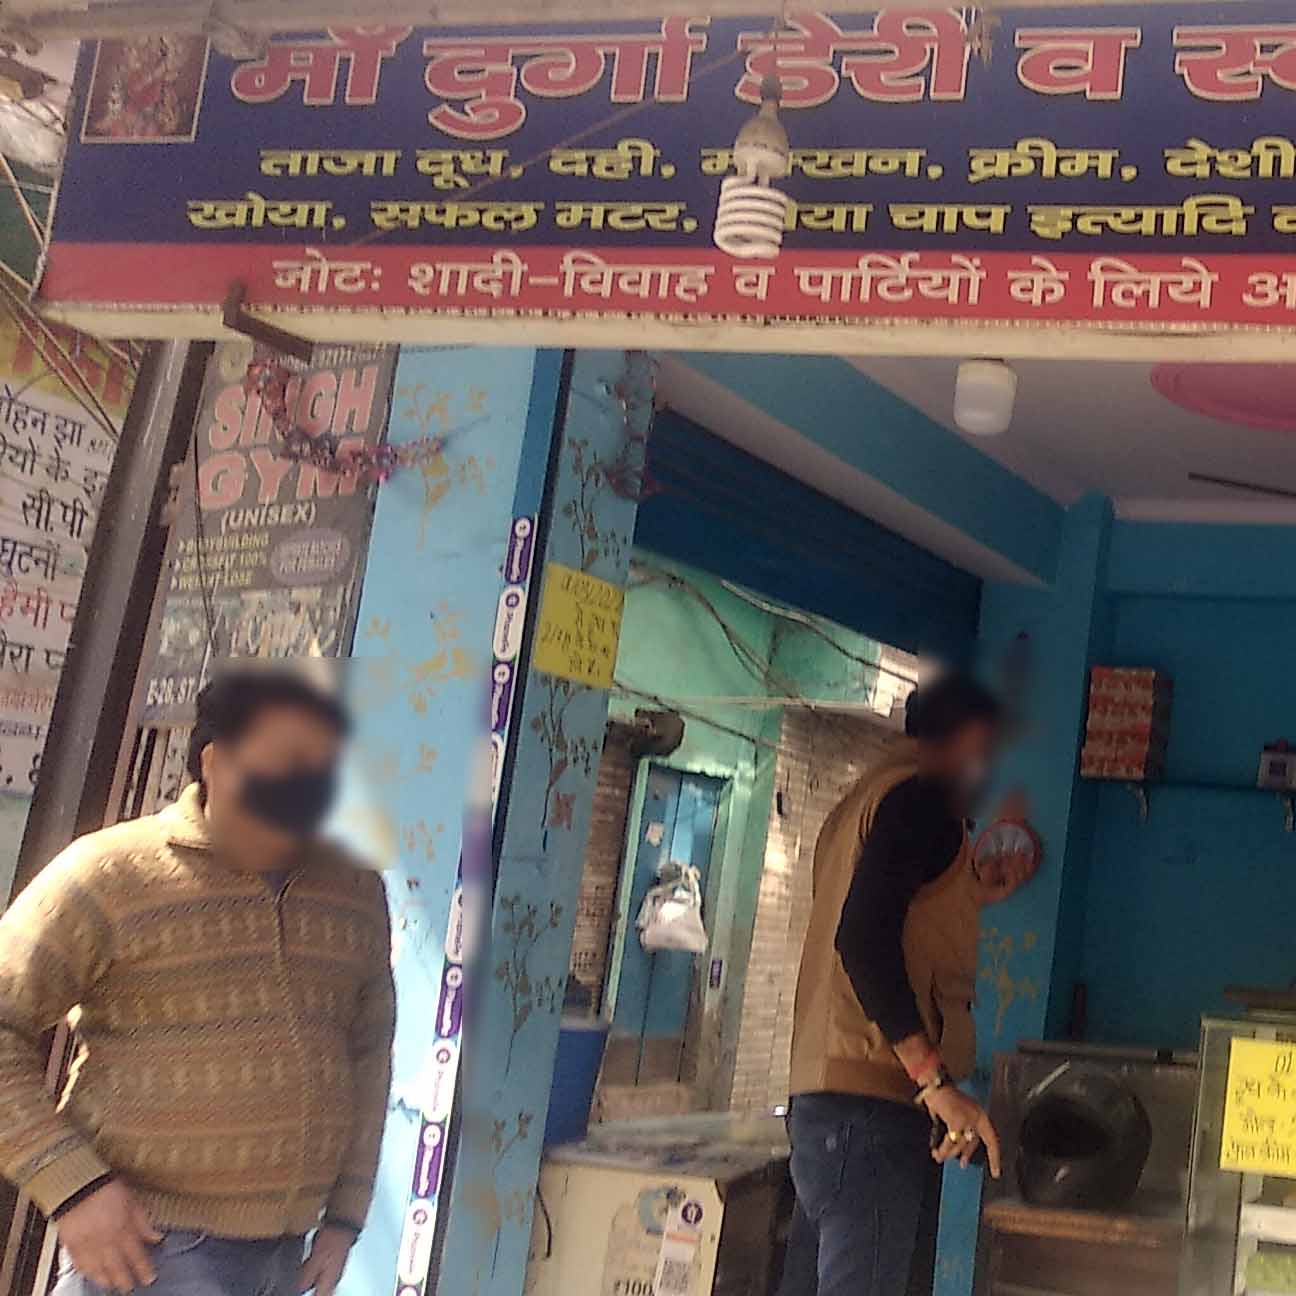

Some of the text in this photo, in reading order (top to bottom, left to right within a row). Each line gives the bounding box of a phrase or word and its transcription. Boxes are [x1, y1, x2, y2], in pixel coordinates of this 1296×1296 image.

[734, 6, 969, 109] डेरी
[1014, 27, 1141, 100] व
[260, 148, 400, 178] ताजा
[370, 201, 545, 232] सफल
[1027, 194, 1255, 240] इत्यादि
[732, 266, 775, 301] व
[794, 252, 987, 305] पार्टियों
[1007, 256, 1070, 305] के
[1088, 257, 1220, 308] लिये
[208, 363, 380, 451] SINGH
[221, 500, 317, 536] (UNISEX)
